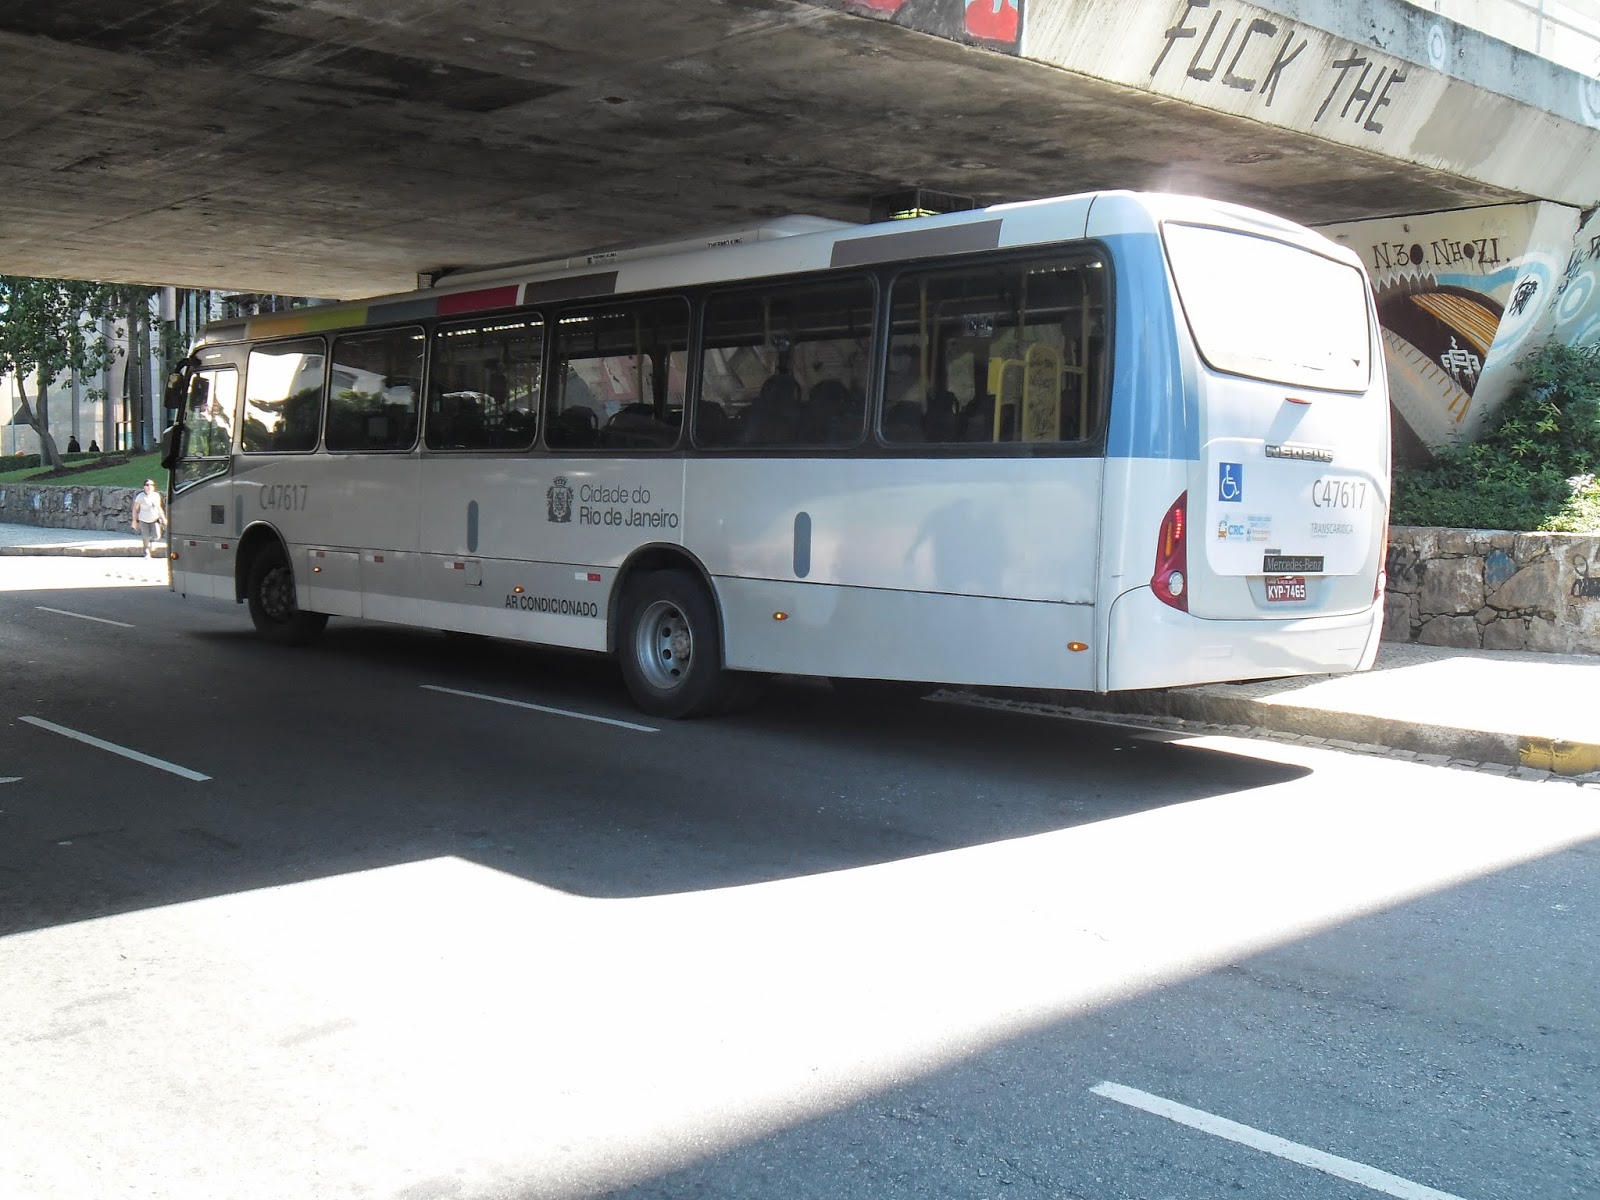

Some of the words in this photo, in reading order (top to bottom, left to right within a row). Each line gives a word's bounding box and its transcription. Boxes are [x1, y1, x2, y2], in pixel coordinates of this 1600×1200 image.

[1150, 0, 1308, 107] FUCK
[1313, 49, 1407, 134] THE
[259, 484, 308, 511] C47617
[580, 484, 629, 504] Cidade
[631, 485, 651, 504] do
[1312, 479, 1366, 509] C47617
[580, 506, 601, 525] Rio
[603, 507, 622, 526] de
[624, 507, 679, 528] Janeiro
[1228, 524, 1244, 535] CRC
[1266, 557, 1322, 571] Mercedes-Benz
[1268, 585, 1305, 599] KYP-7465
[505, 595, 519, 609] AR
[520, 596, 598, 618] CONDICIONADO
